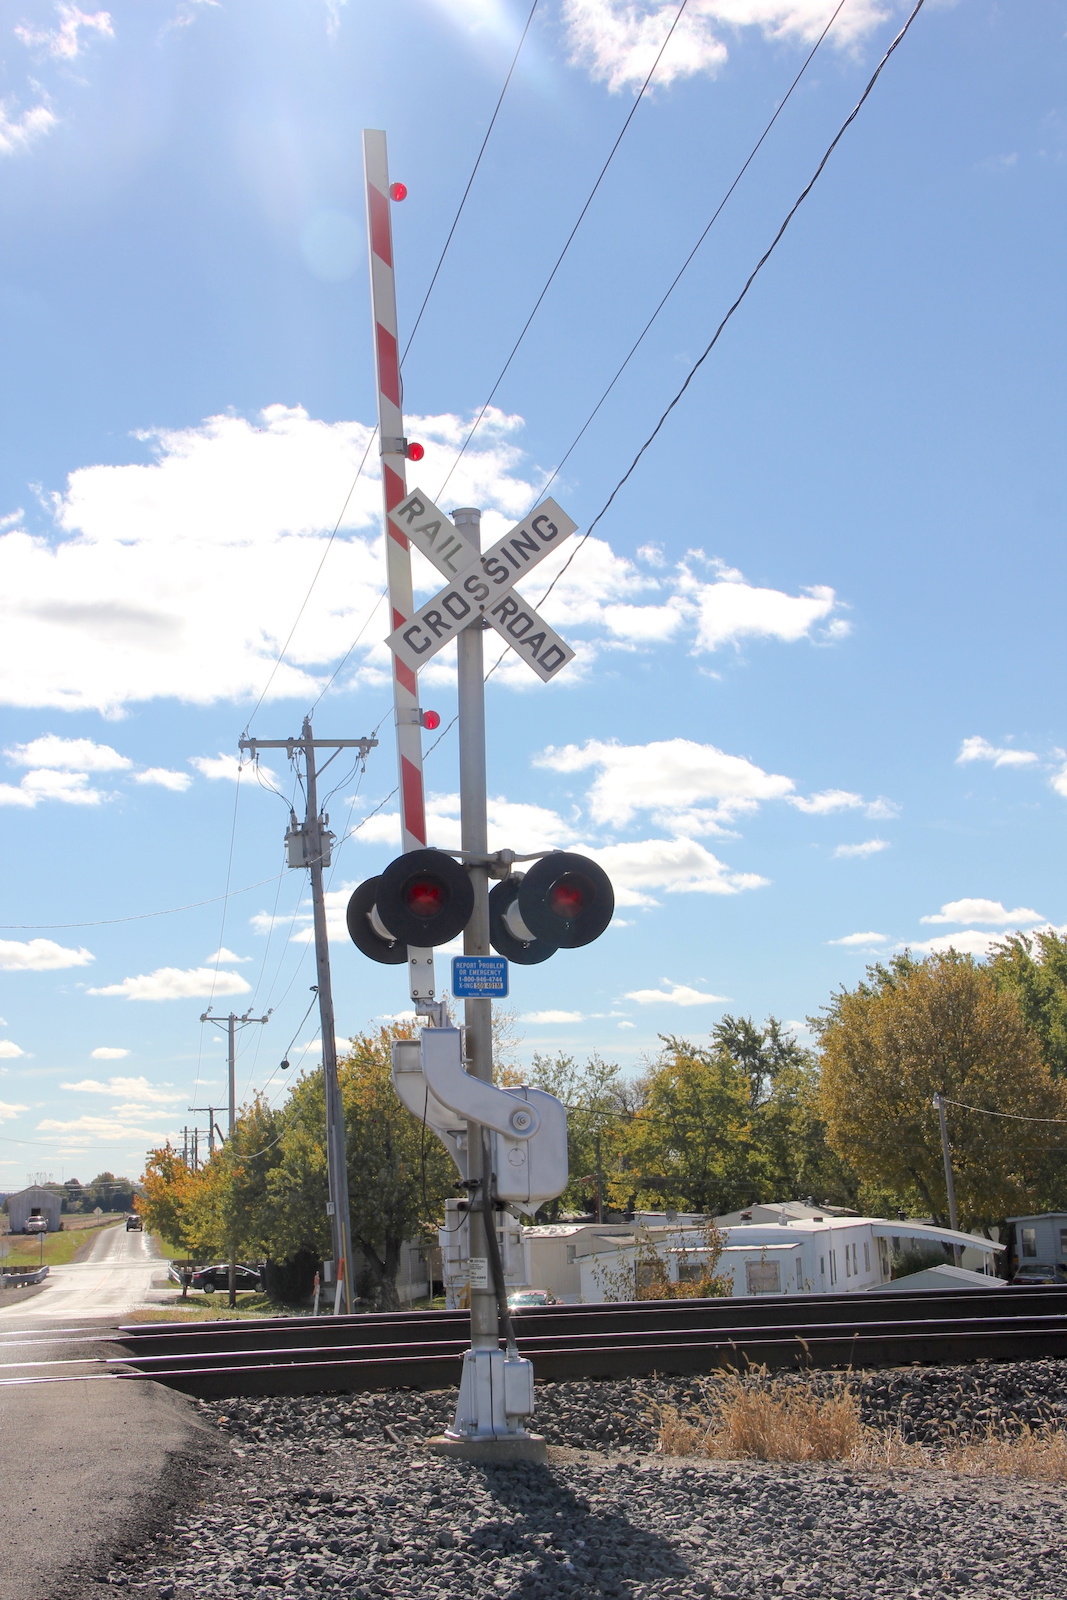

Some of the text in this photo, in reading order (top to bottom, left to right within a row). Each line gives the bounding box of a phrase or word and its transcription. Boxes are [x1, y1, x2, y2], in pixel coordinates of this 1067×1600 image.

[397, 496, 566, 672] RAIL ROAD
[403, 514, 558, 654] CROSSING
